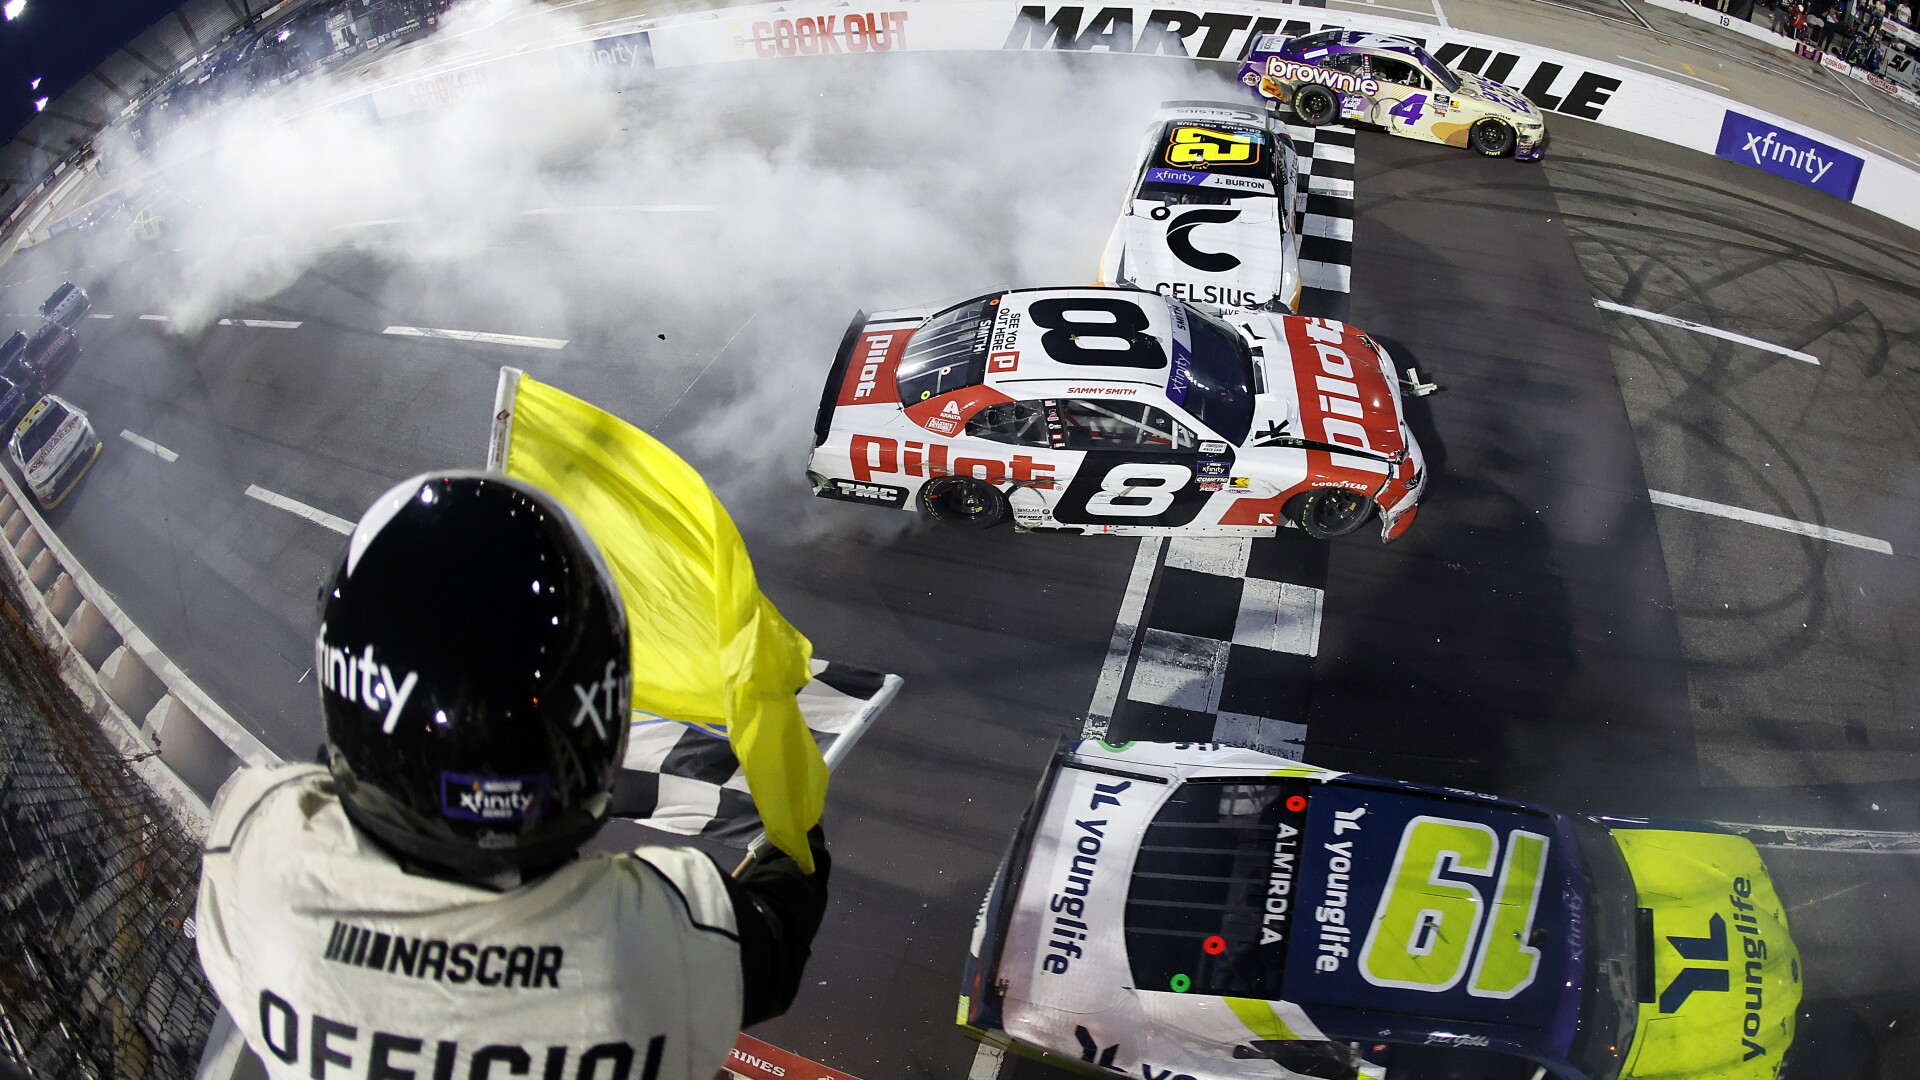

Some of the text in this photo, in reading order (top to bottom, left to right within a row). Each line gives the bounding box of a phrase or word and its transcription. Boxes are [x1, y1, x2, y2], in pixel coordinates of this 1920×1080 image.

[752, 11, 908, 58] COOK OUT
[1719, 15, 1730, 26] 19
[573, 41, 638, 73] xfinity
[1003, 5, 1623, 120] MARTIVILLE
[1268, 57, 1378, 96] brownie
[1388, 93, 1428, 126] 4
[1155, 170, 1196, 184] xfinity
[1742, 131, 1834, 183] xfinity
[1225, 179, 1265, 189] BURTON
[1156, 282, 1257, 311] CELSIUS
[971, 318, 993, 354] SMITH
[991, 308, 1011, 351] OUT HERE
[1003, 312, 1021, 350] SEE YOU
[1028, 297, 1168, 370] 8
[1067, 387, 1138, 396] SAMMY SMITH
[1171, 352, 1190, 395] xfinity
[850, 434, 1055, 489] pilot
[1202, 465, 1225, 473] xfinity
[837, 481, 898, 501] TMC
[1085, 463, 1192, 517] 8
[1311, 480, 1368, 491] GOODYEAR
[316, 622, 419, 735] finity
[1042, 818, 1108, 976] younglife
[1259, 822, 1299, 946] ALMIROLA
[1315, 840, 1353, 973] younglife
[1357, 815, 1551, 1000] 19
[386, 935, 564, 989] NASCAR
[1728, 876, 1768, 1062] younglife
